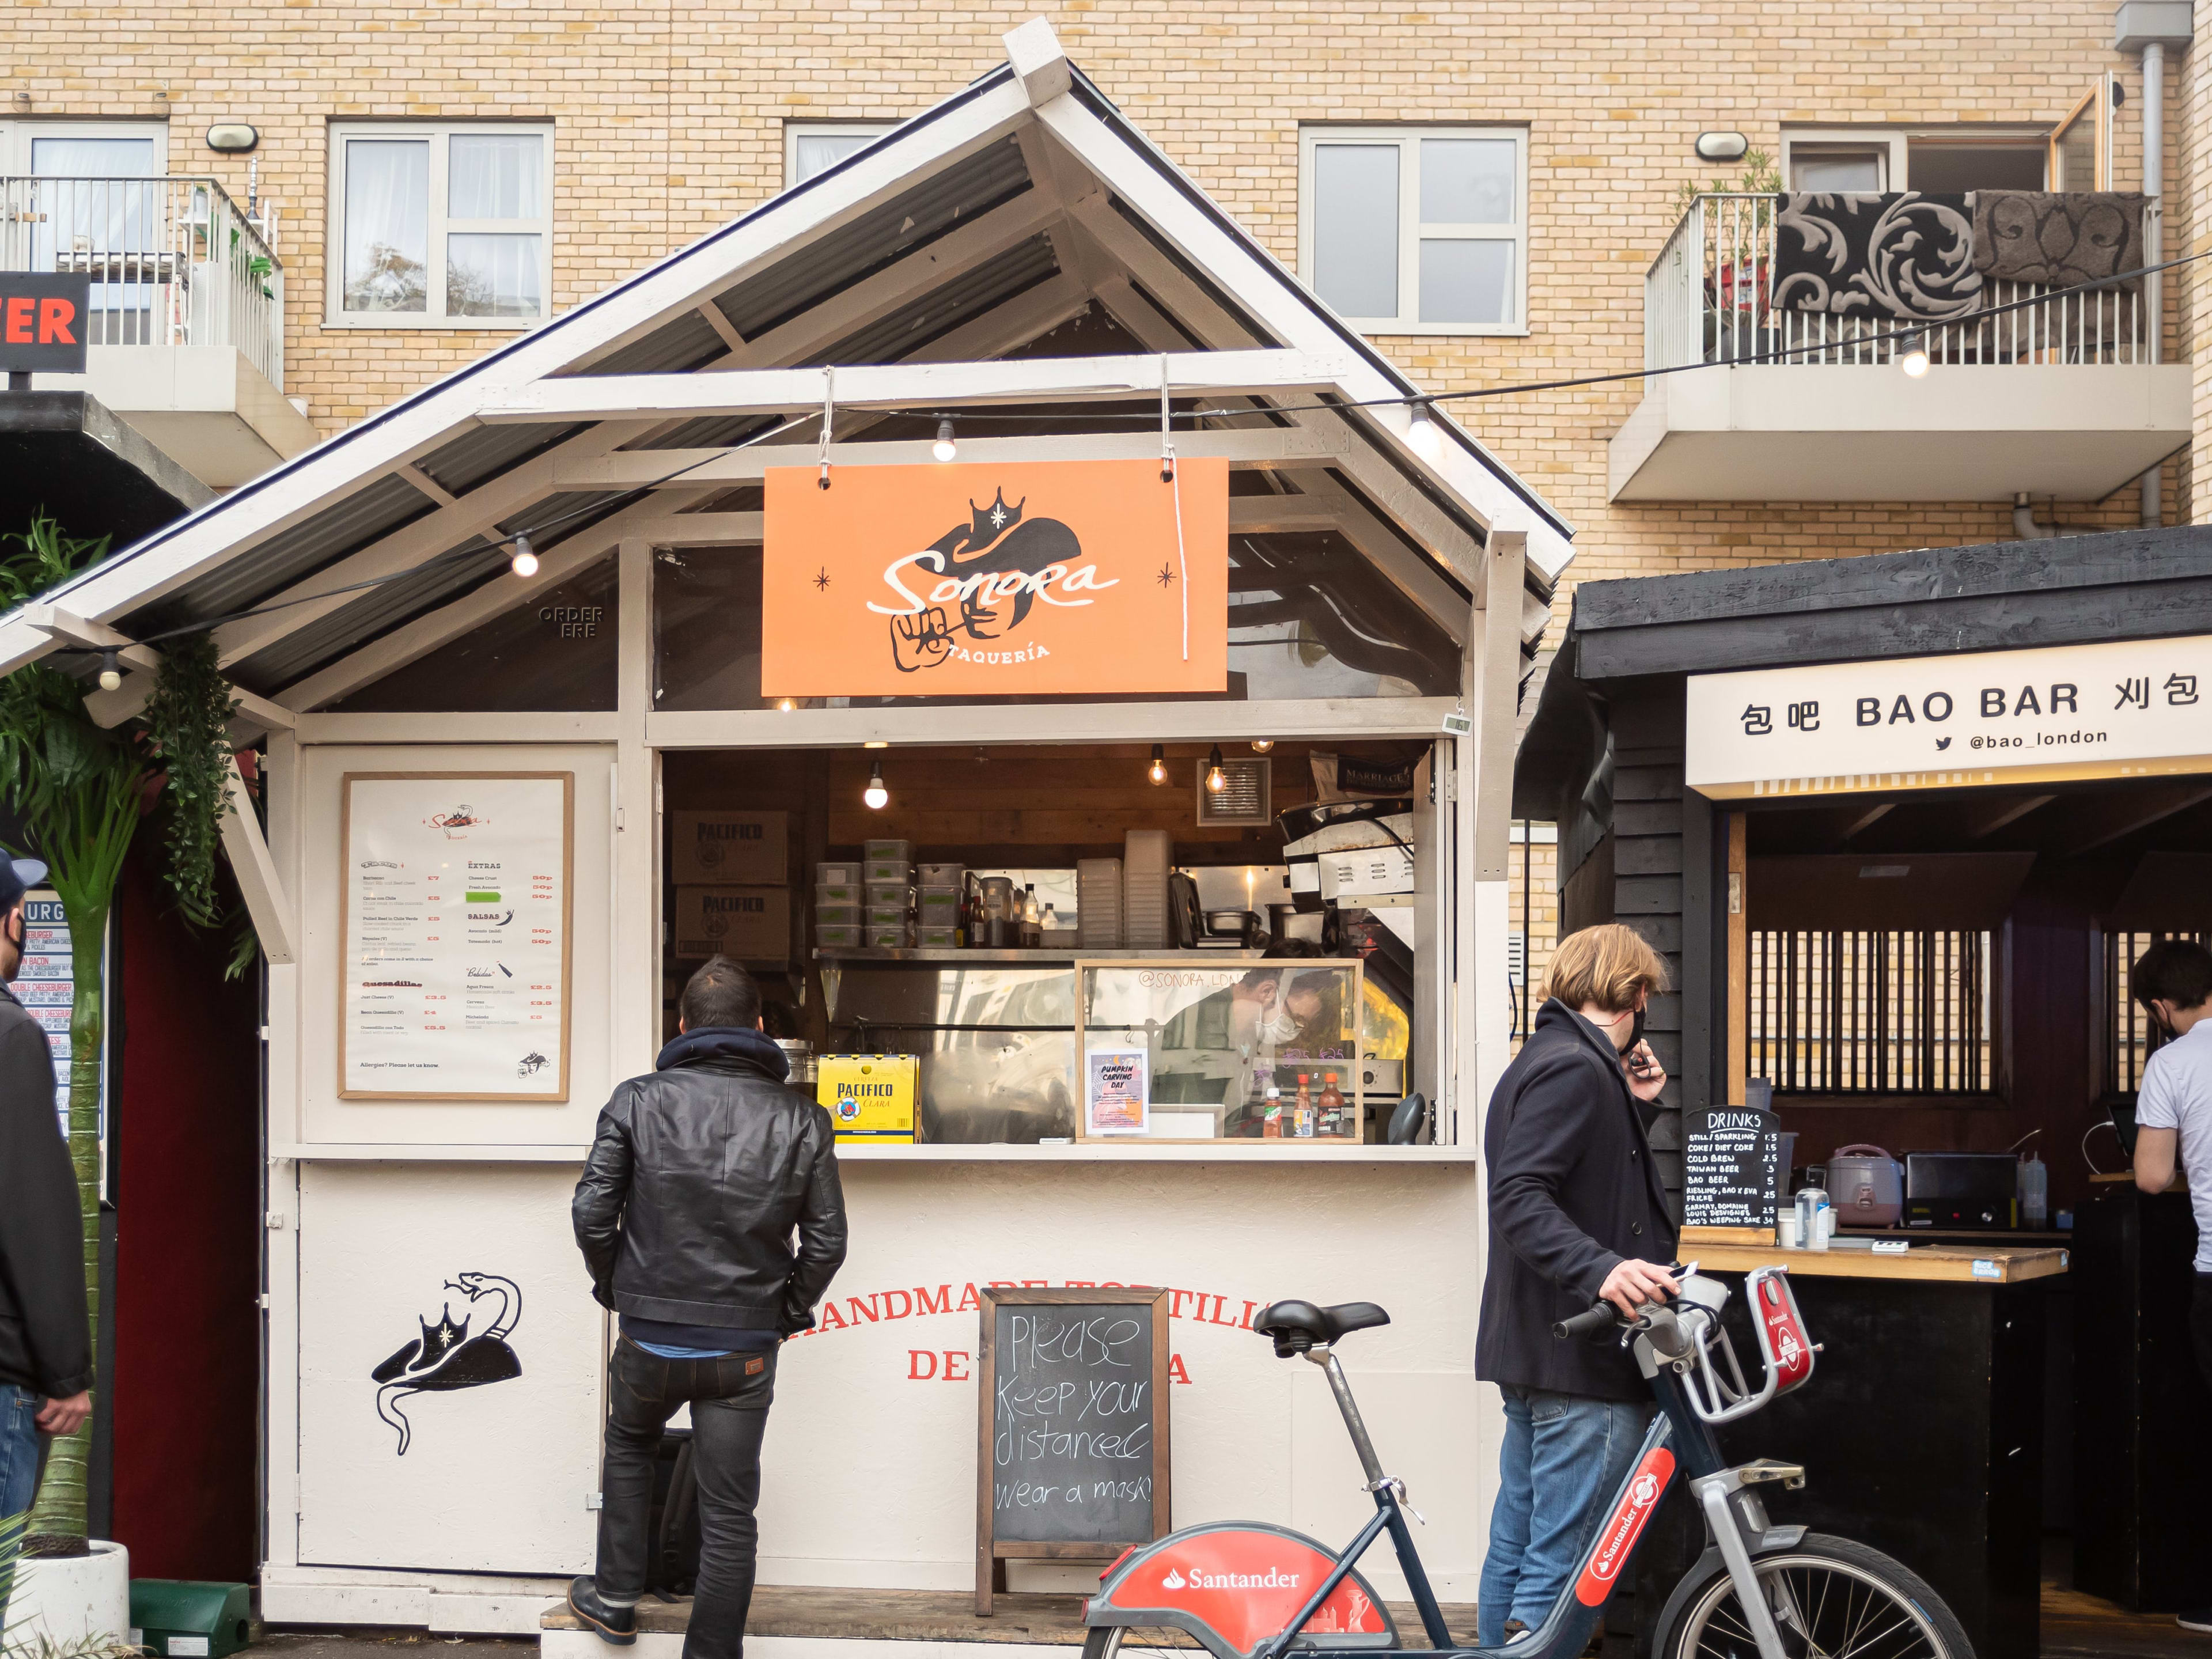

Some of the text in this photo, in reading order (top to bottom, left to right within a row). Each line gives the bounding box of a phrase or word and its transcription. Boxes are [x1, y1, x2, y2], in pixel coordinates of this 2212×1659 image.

[0, 298, 77, 344] ER
[539, 607, 603, 622] ORDER
[948, 641, 1050, 665] TAQUERÍA
[1857, 691, 1953, 727] BAO
[1980, 683, 2078, 718] BAR
[1970, 730, 2107, 749] @bao_london
[697, 822, 763, 841] PACIFICO
[703, 895, 764, 914] PACIFICO
[26, 930, 53, 938] EBURGER
[10, 983, 72, 991] DOUBLE CHEESEBURGER
[838, 1082, 893, 1098] PACIFICO
[863, 1099, 890, 1107] CLARA
[1707, 1112, 1761, 1129] DRINKS
[1714, 1133, 1757, 1141] SPARKLING
[1710, 1154, 1735, 1162] BREW
[1762, 1154, 1778, 1162] 2.5
[1687, 1176, 1774, 1185] BAO BEER 5
[1763, 1191, 1775, 1199] 25
[1763, 1217, 1774, 1225] 34
[1012, 1315, 1140, 1372] Please
[908, 1350, 969, 1381] DE
[1066, 1484, 1082, 1503] a
[1603, 1508, 1638, 1562] Santander
[1189, 1566, 1300, 1589] Santander
